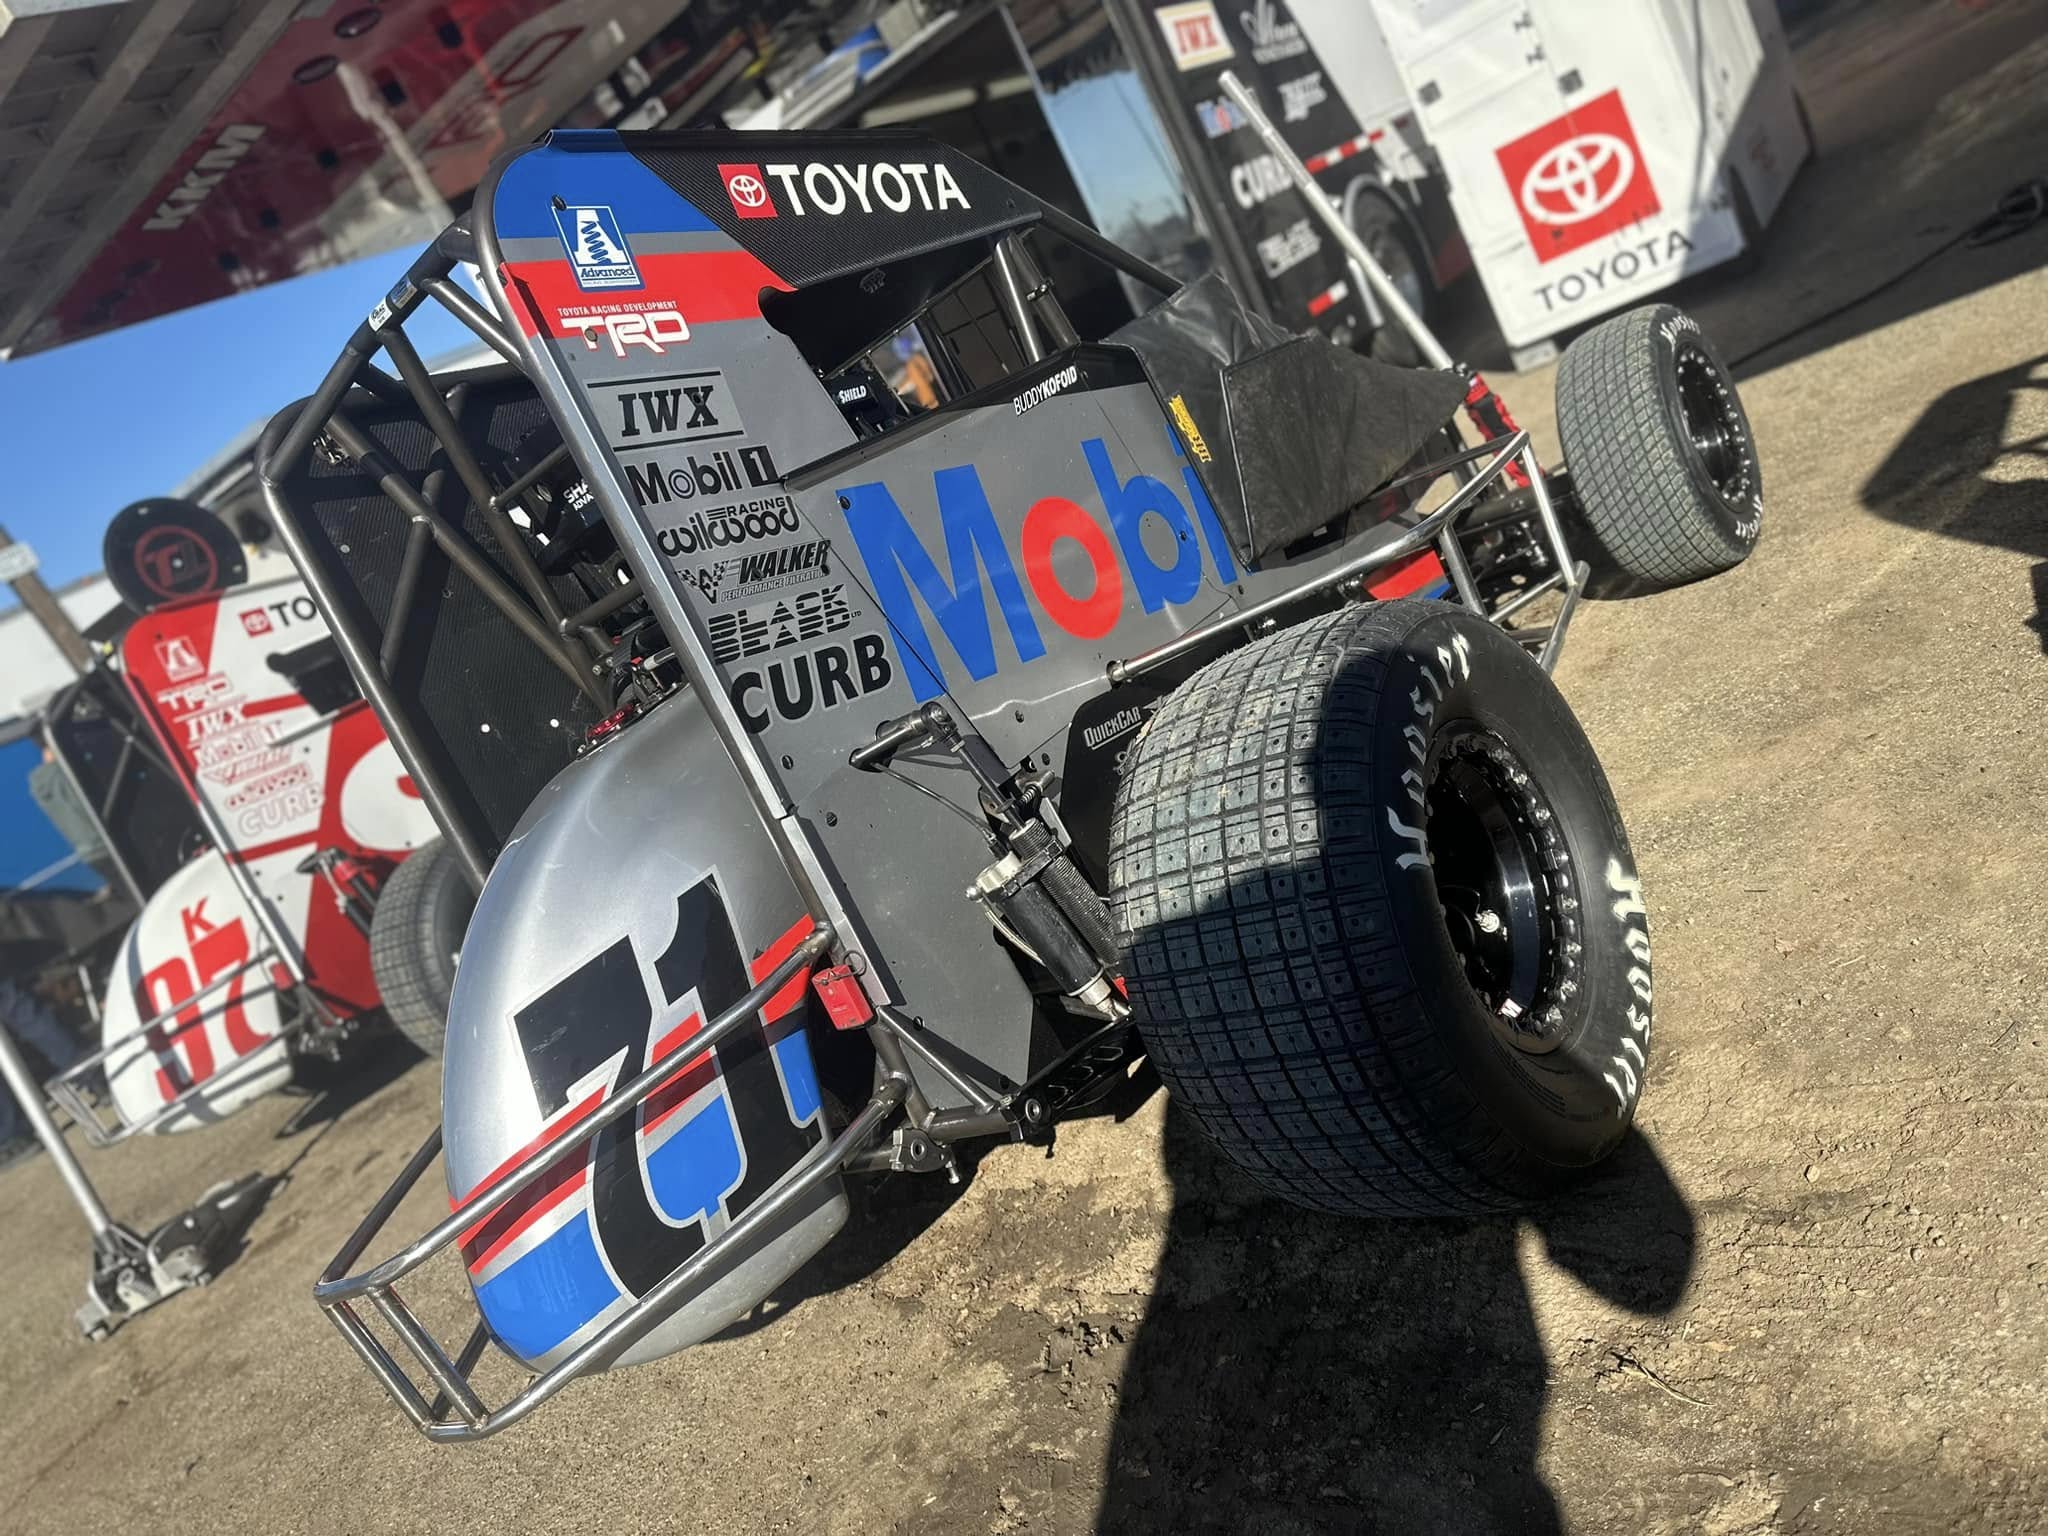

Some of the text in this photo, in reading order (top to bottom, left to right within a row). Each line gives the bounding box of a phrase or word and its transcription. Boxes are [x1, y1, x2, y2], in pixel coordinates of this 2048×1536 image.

[142, 125, 267, 231] KKM
[765, 162, 971, 216] TOYOTA
[580, 266, 635, 279] Advanced
[1533, 229, 1695, 312] TOYOTA
[557, 300, 678, 317] TOYOTA RACING DEVELOPMENT
[560, 310, 691, 357] TRD
[618, 384, 719, 438] IWX
[838, 385, 867, 404] SHIELD
[624, 450, 742, 507] Mobil
[727, 496, 786, 518] RACING
[720, 568, 829, 603] PERFORMANCE FILTRATIO
[738, 540, 832, 585] WALKER
[836, 424, 1256, 704] Mobi
[707, 583, 848, 641] BLACK
[711, 606, 851, 666] BEARD
[730, 634, 893, 735] CURB
[186, 702, 245, 742] IWX
[238, 783, 326, 837] CURB
[512, 872, 825, 1300] 71
